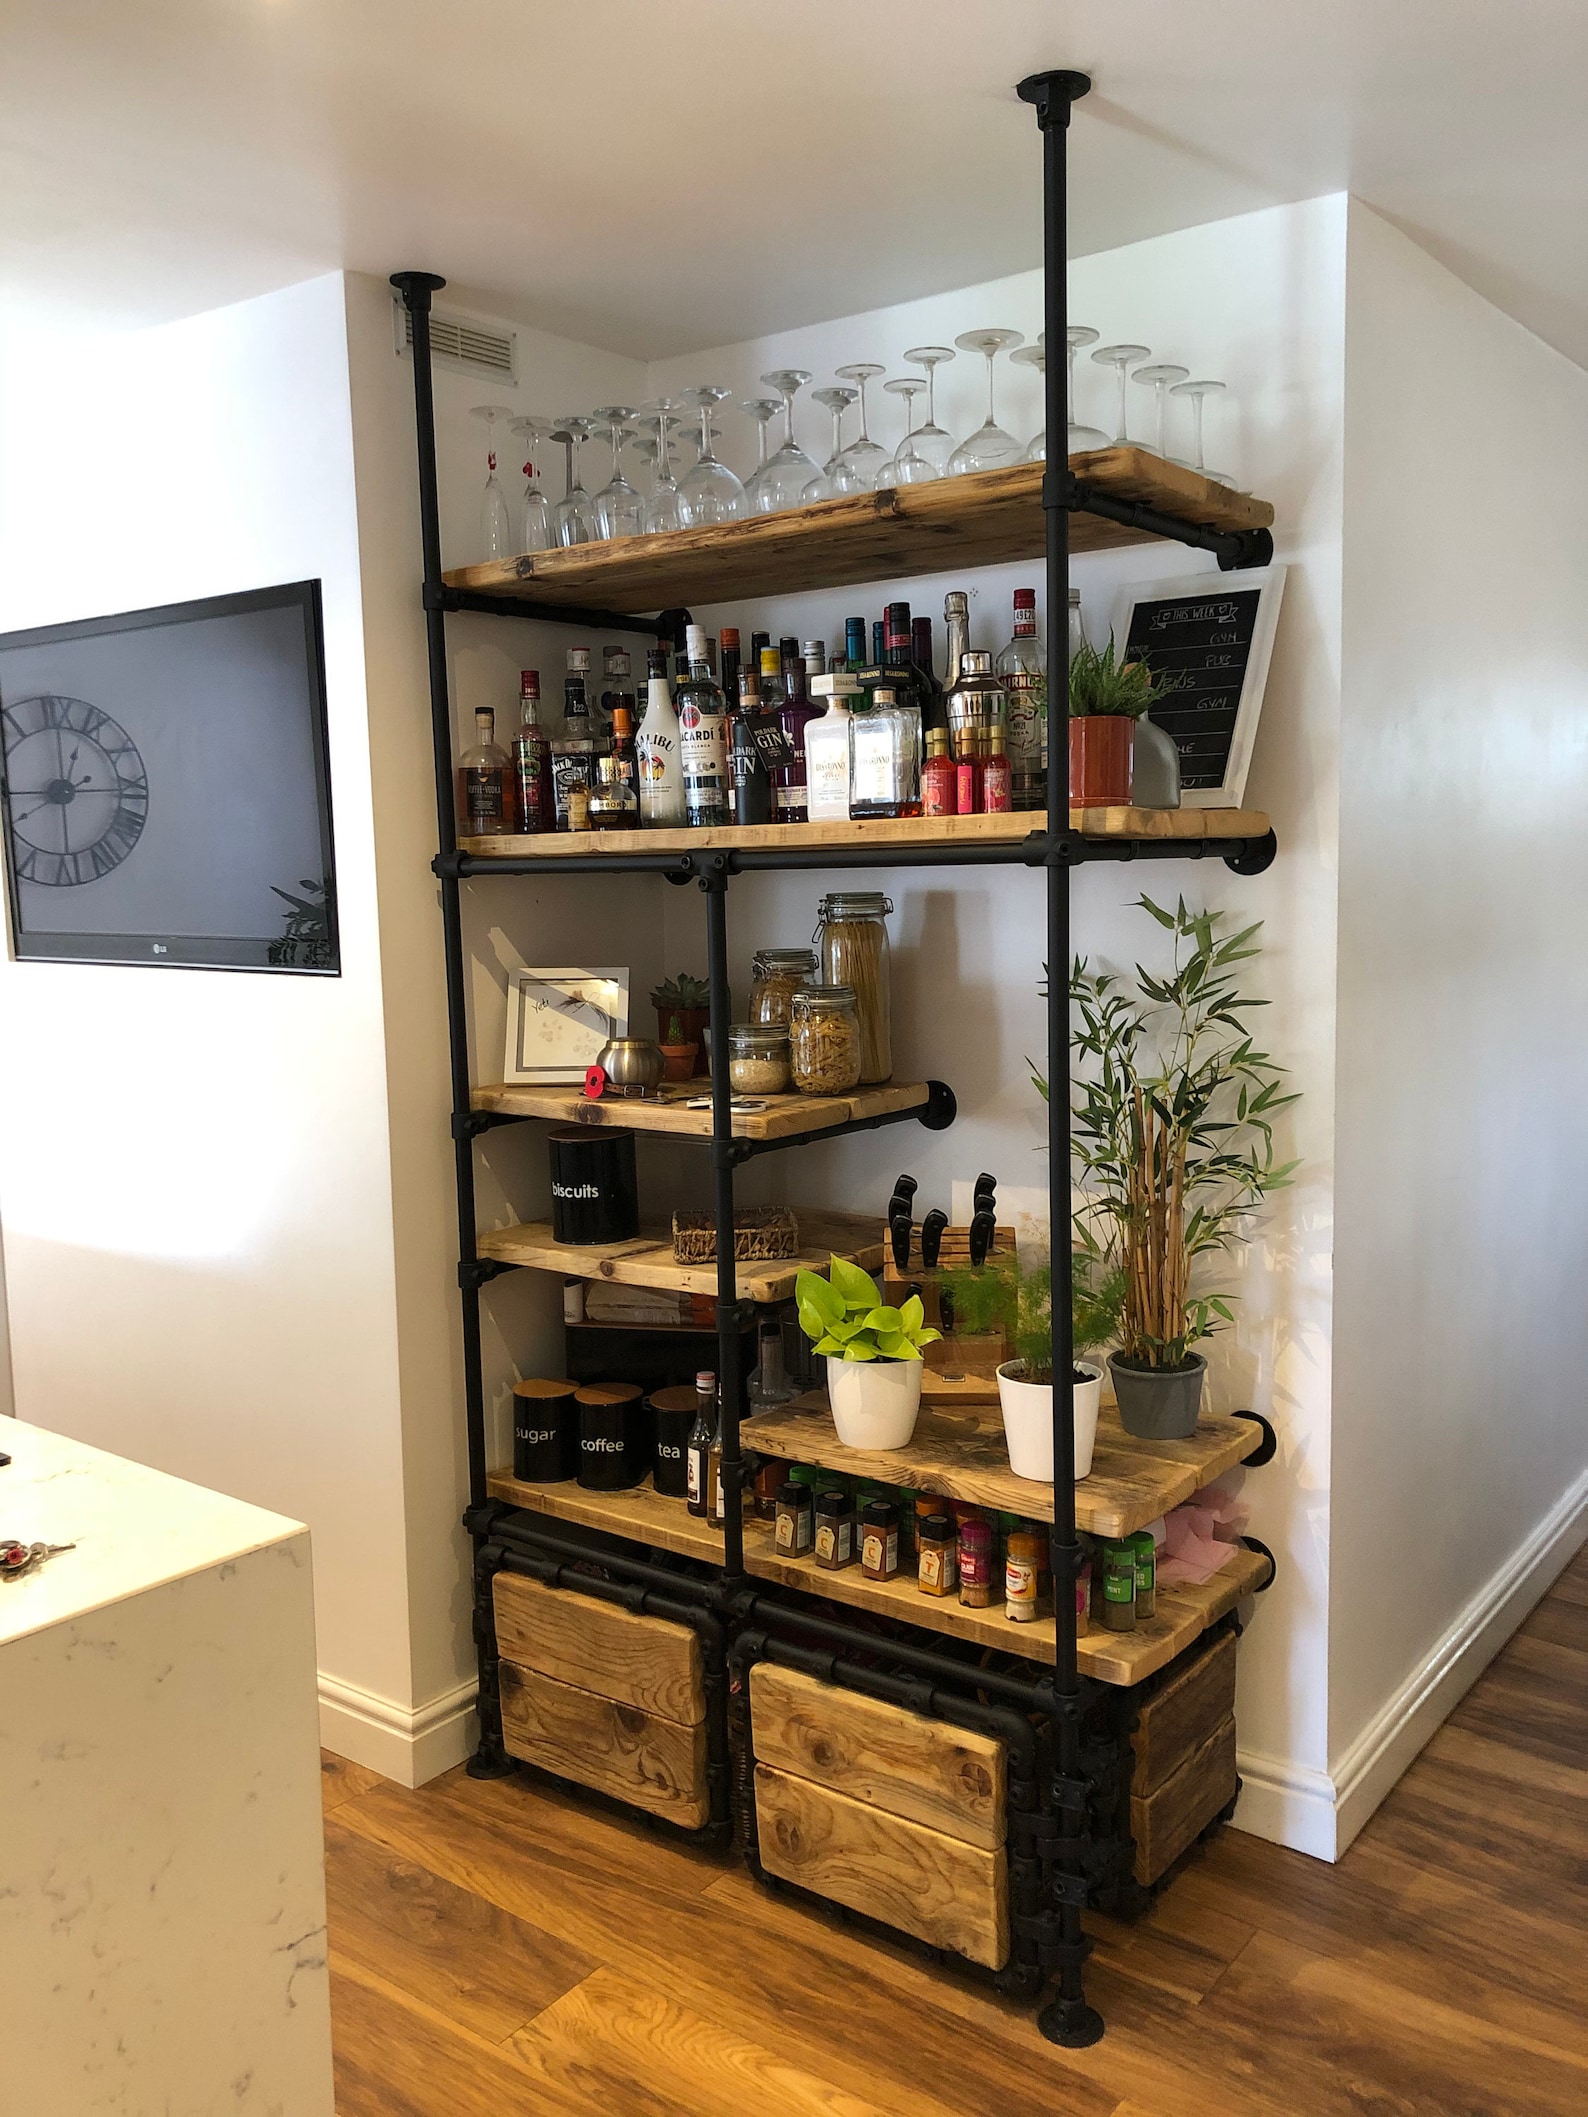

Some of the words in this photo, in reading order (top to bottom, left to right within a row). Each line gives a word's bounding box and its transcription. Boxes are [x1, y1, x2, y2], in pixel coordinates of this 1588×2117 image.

[757, 732, 783, 749] GIN
[734, 756, 756, 775] IN
[551, 1181, 600, 1199] biscuits
[516, 1426, 557, 1445] sugar
[580, 1438, 625, 1453] coffee
[657, 1442, 681, 1459] tea
[780, 1524, 788, 1536] C
[820, 1537, 828, 1549] C
[868, 1546, 876, 1559] C
[925, 1560, 934, 1574] T
